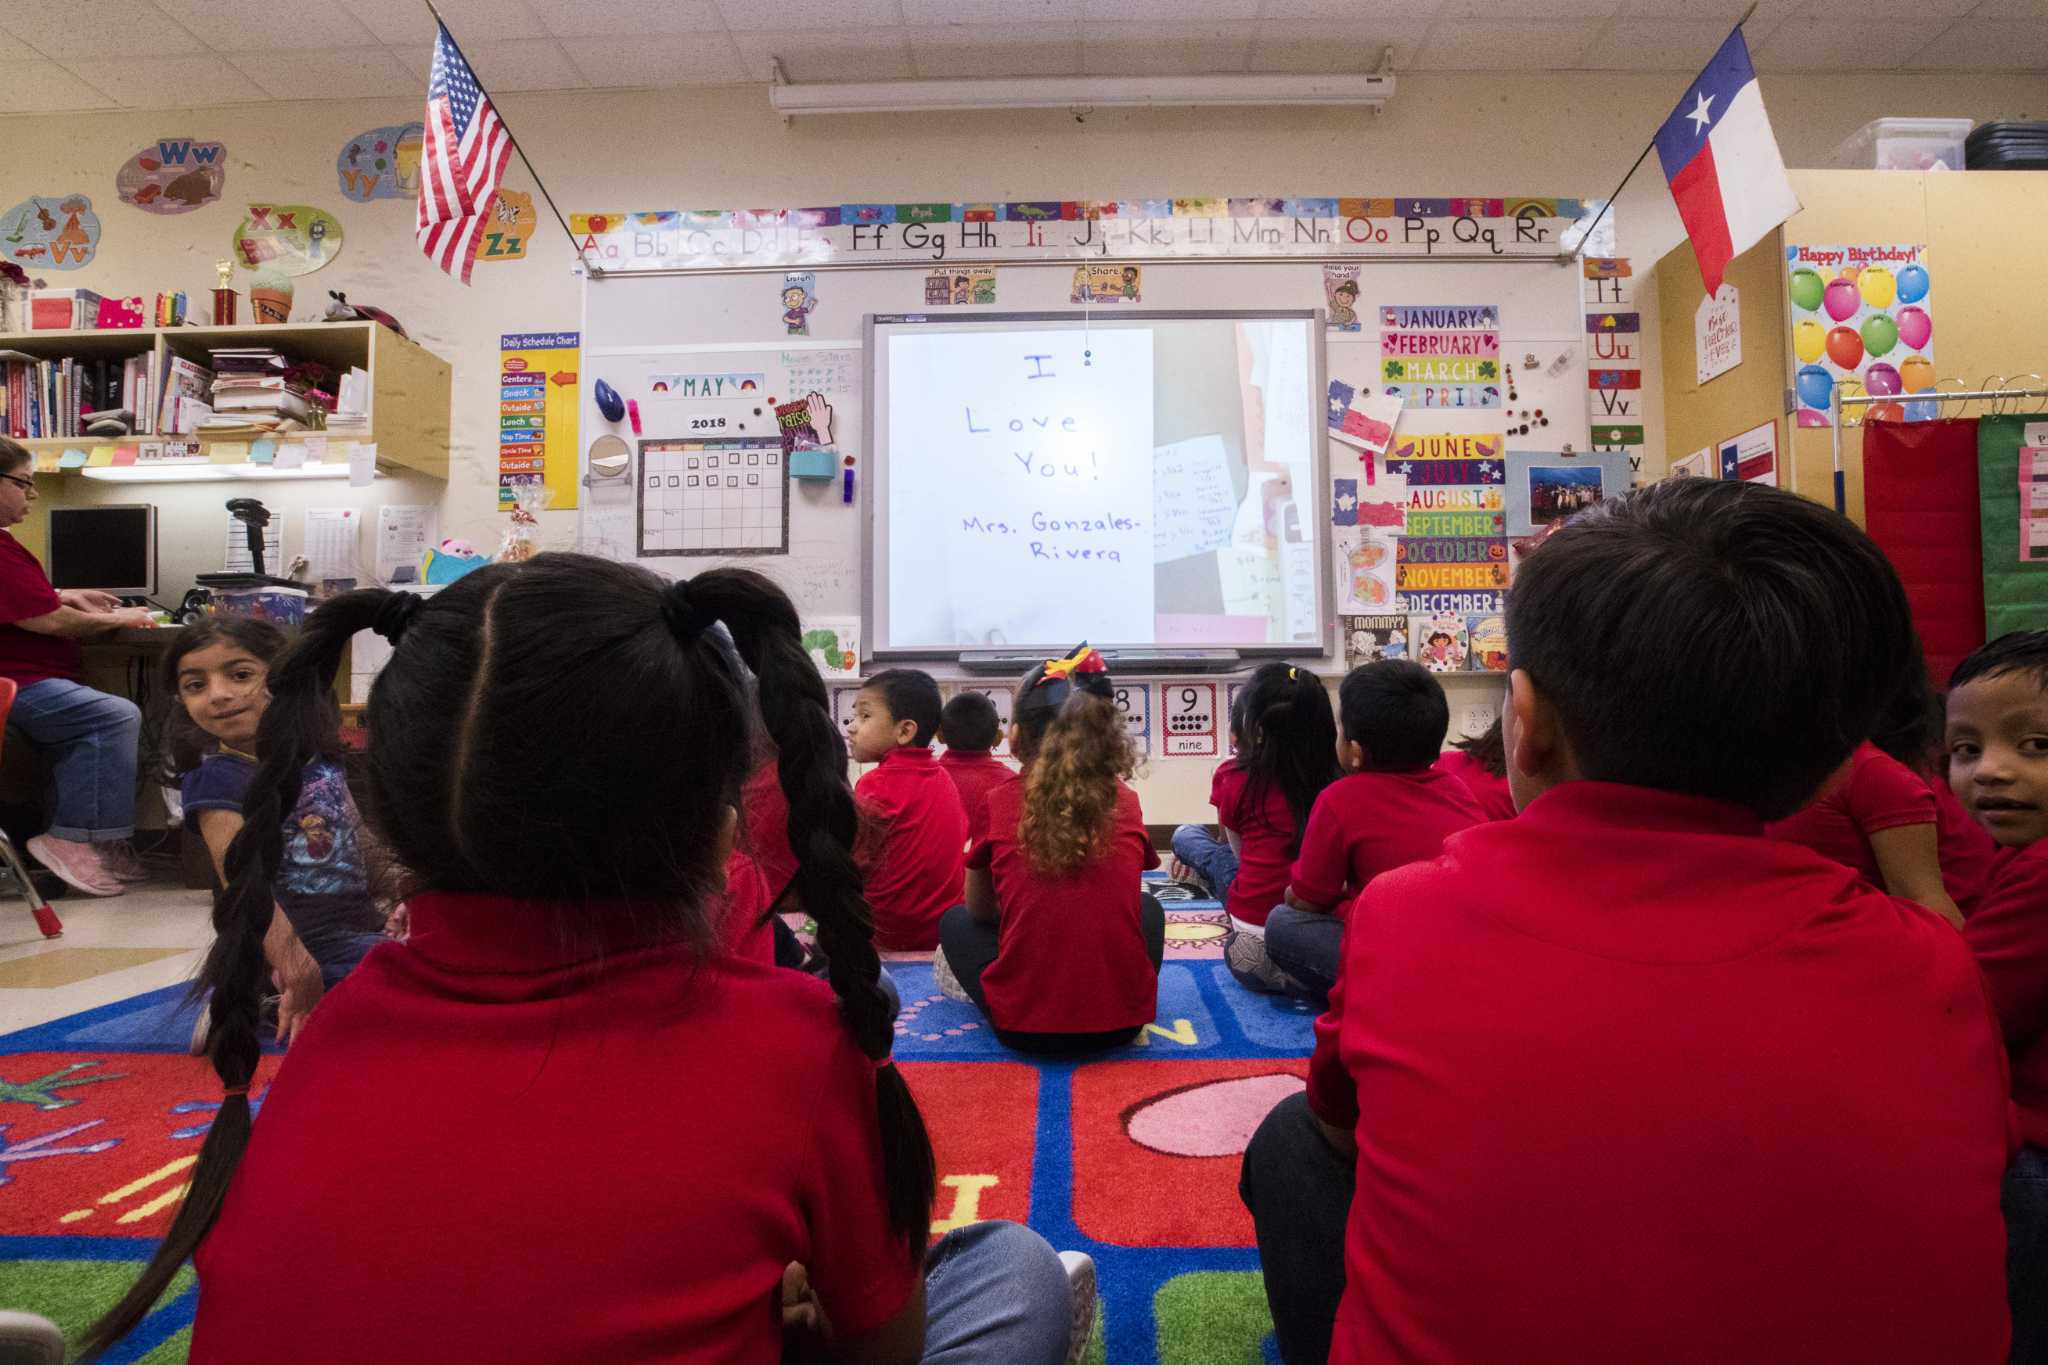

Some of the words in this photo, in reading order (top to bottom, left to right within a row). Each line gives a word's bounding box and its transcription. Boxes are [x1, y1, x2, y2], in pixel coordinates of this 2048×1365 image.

[159, 142, 219, 165] Ww
[341, 169, 379, 197] Yy
[249, 207, 297, 231] Xx
[485, 233, 521, 256] Zz
[582, 234, 618, 258] Aa
[634, 231, 668, 257] Bb
[687, 230, 728, 256] Cc
[742, 229, 779, 255] Dd
[853, 224, 889, 250] Ff
[902, 223, 945, 260] Gg
[961, 221, 997, 248] Hh
[1026, 220, 1043, 248] Ii
[1128, 217, 1168, 245] Kk
[1188, 217, 1214, 243] Ll
[1233, 217, 1281, 244] Mm
[1294, 216, 1330, 243] Nn
[1346, 216, 1388, 243] Oo
[1405, 216, 1440, 254] Pp
[1452, 216, 1504, 254] Qq
[1515, 216, 1549, 242] Rr
[49, 241, 88, 264] Vv
[1798, 246, 1844, 266] Happy
[1847, 245, 1917, 263] Birthday!
[1588, 276, 1622, 303] Tt
[1399, 309, 1479, 329] JANUARY
[503, 337, 521, 348] Daily
[522, 336, 555, 347] Schedule
[556, 335, 577, 345] Chart
[1399, 334, 1482, 355] FEBRUARY
[1595, 332, 1630, 359] Uu
[1023, 355, 1057, 379] I
[1407, 362, 1477, 381] MARCH
[503, 389, 529, 398] Snack
[683, 376, 725, 397] MAY
[1409, 386, 1480, 407] APRIL
[502, 403, 532, 411] Outside
[1599, 389, 1630, 415] Vv
[502, 418, 526, 426] Lunch
[690, 417, 727, 429] 2018
[777, 409, 811, 431] raise
[966, 406, 1078, 433] Love
[1416, 438, 1472, 458] JUNE
[500, 462, 530, 470] Outside
[1013, 451, 1099, 481] You!
[1423, 463, 1469, 484] JULY
[1411, 489, 1483, 509] AUGUST
[962, 516, 1017, 534] Mrs.
[1031, 511, 1142, 532] Gonzales-
[1407, 515, 1493, 536] SEPTEMBER
[1029, 541, 1122, 563] Rivera
[1407, 541, 1489, 562] OCTOBER
[1404, 567, 1493, 587] NOVEMBER
[1410, 593, 1492, 614] DECEMBER
[1115, 688, 1130, 713] 8
[1181, 688, 1198, 713] 9
[1178, 739, 1203, 750] nine
